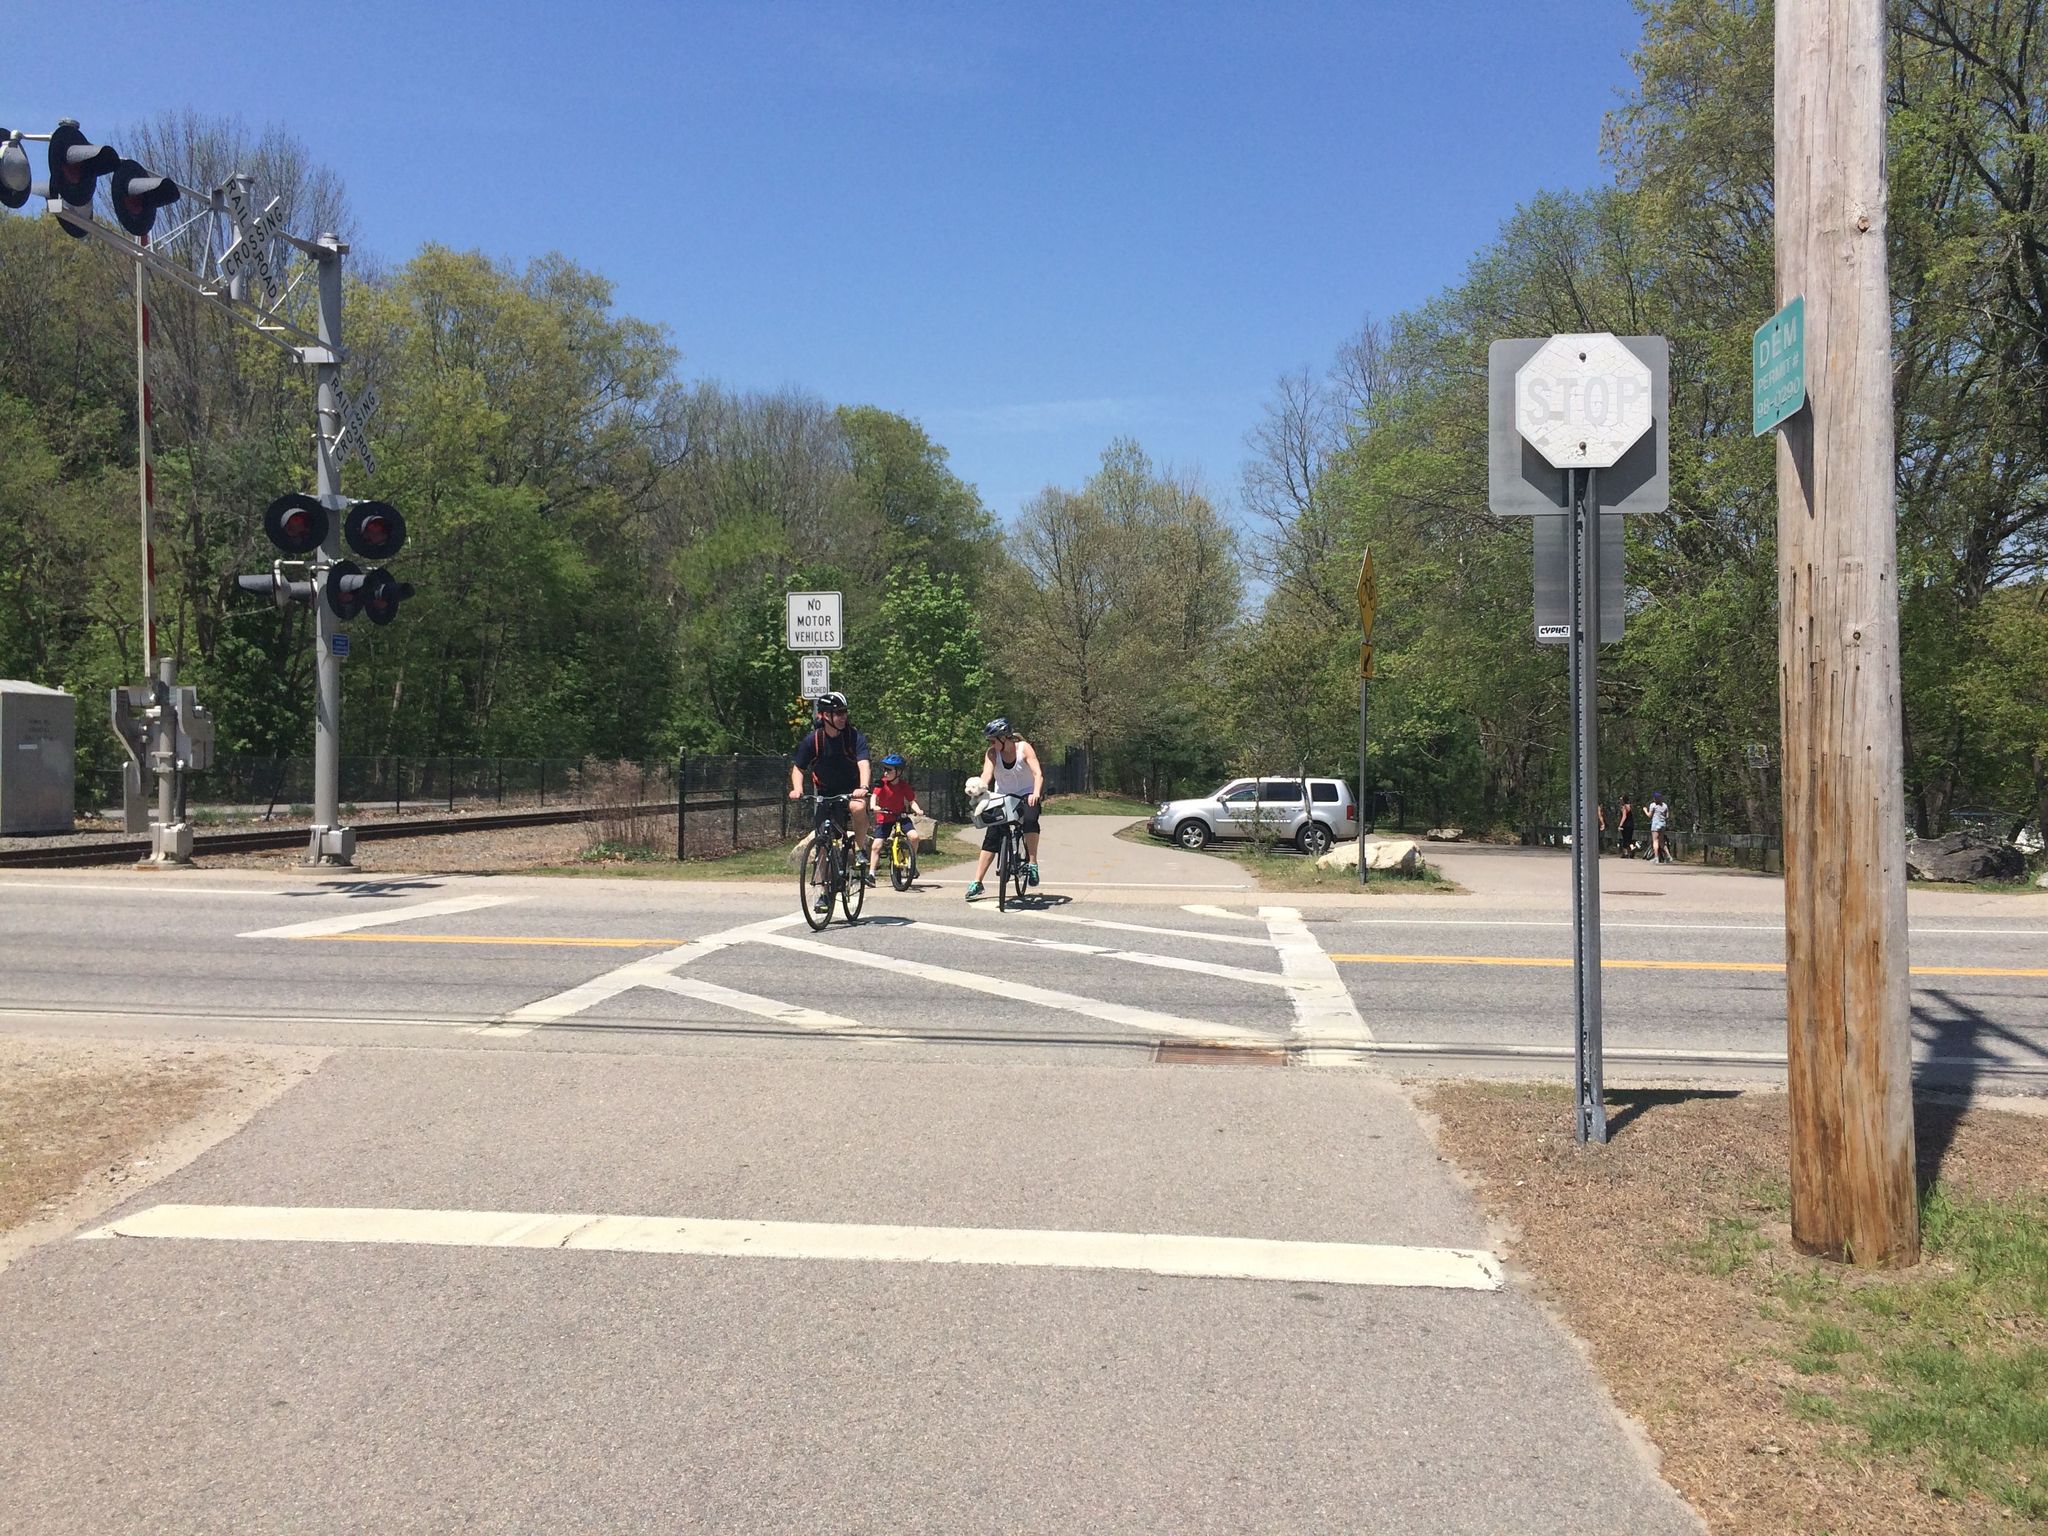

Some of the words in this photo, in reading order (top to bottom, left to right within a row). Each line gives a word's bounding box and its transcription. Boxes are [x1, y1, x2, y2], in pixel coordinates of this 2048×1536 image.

[226, 178, 248, 228] RAIL
[254, 250, 277, 298] ROAD
[226, 206, 283, 276] CROSSING
[1759, 316, 1797, 369] DEM
[331, 377, 350, 418] RAIL
[356, 434, 376, 474] ROAD
[1526, 375, 1642, 426] STOP
[335, 391, 376, 462] CROSSING
[797, 615, 832, 627] MOTOR
[807, 600, 821, 611] NO
[795, 631, 835, 642] VEHICLES
[804, 686, 827, 694] LEASHED
[807, 661, 823, 669] DOGS
